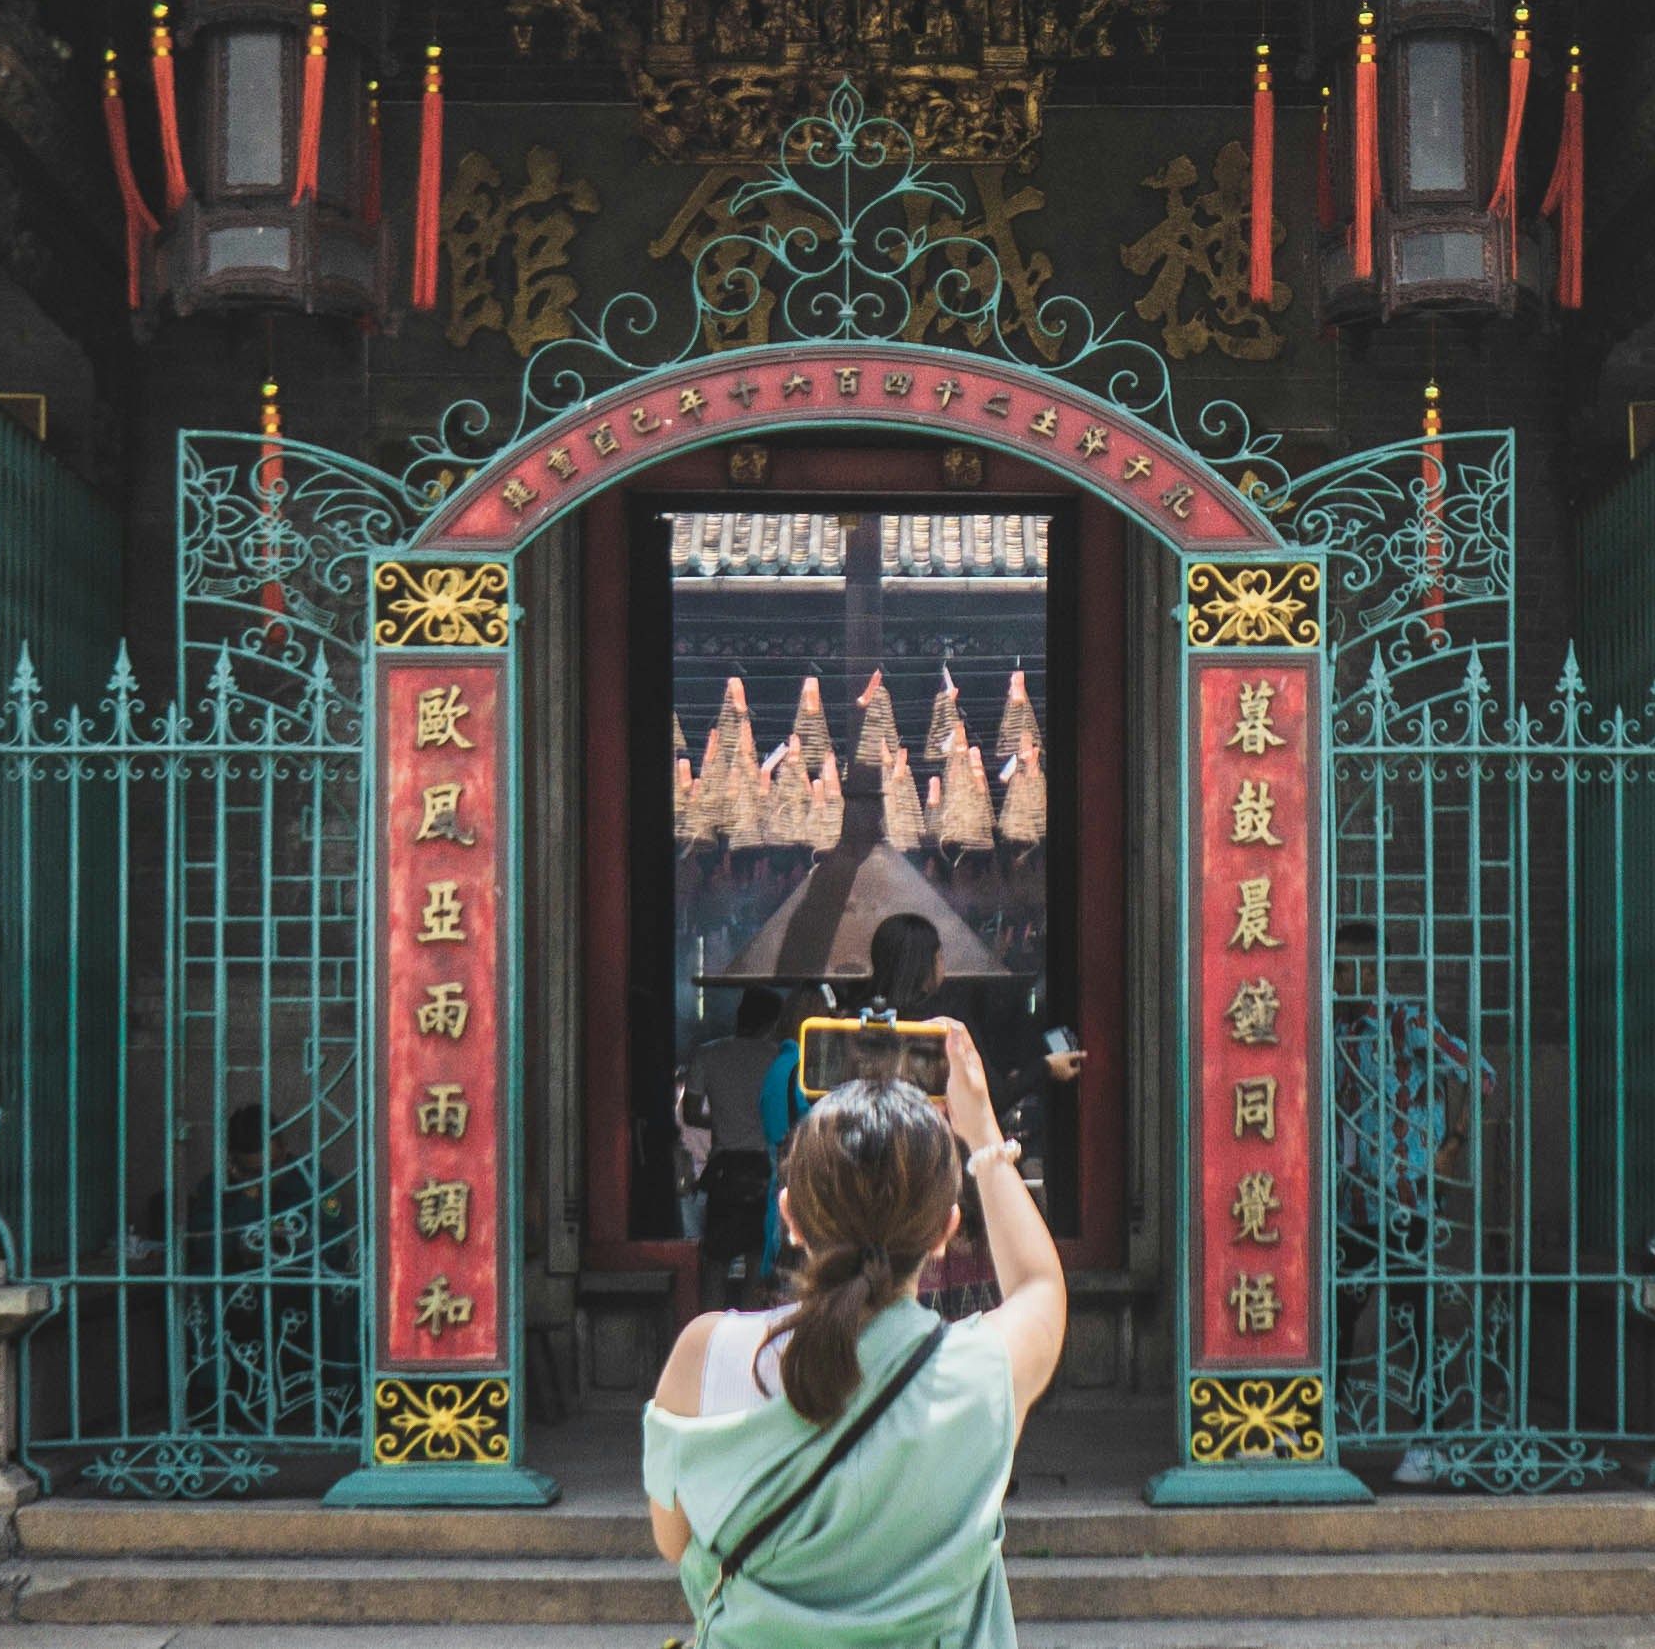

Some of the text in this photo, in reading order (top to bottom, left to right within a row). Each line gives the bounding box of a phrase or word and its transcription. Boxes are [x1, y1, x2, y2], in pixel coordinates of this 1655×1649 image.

[1223, 678, 1287, 1337] 暮鼓晨鐘同覺悟
